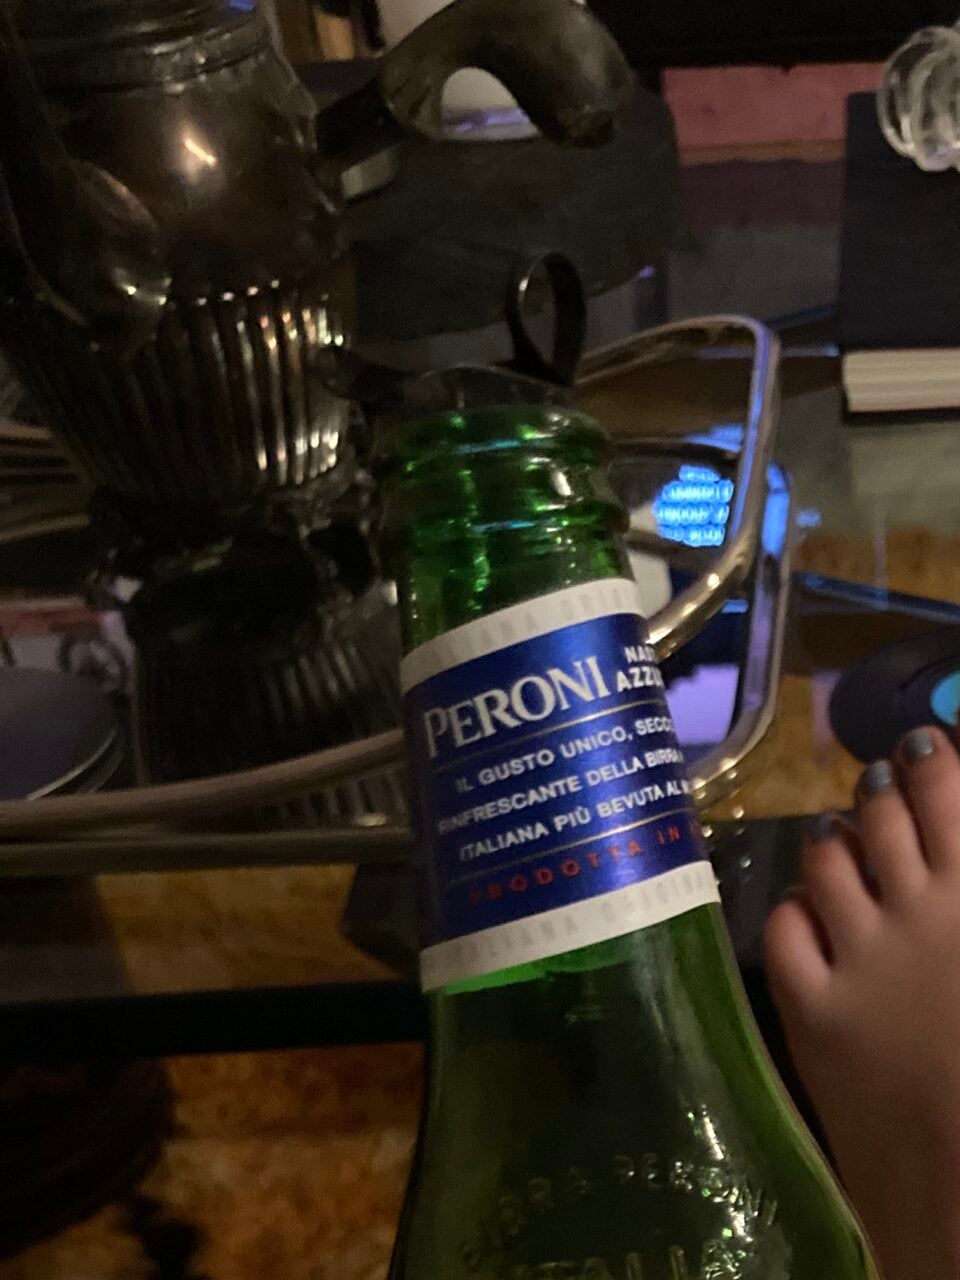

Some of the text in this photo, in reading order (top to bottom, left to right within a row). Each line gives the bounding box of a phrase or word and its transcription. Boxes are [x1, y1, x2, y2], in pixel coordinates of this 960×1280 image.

[423, 655, 611, 758] PERONI
[455, 778, 475, 793] IL
[478, 749, 555, 786] GUSTO
[560, 726, 633, 758] UNICO,
[585, 756, 645, 787] DELLA
[460, 821, 550, 861] ITALIANA
[553, 805, 592, 833] PIÙ
[595, 784, 665, 818] BEVUTA
[665, 779, 683, 796] AL
